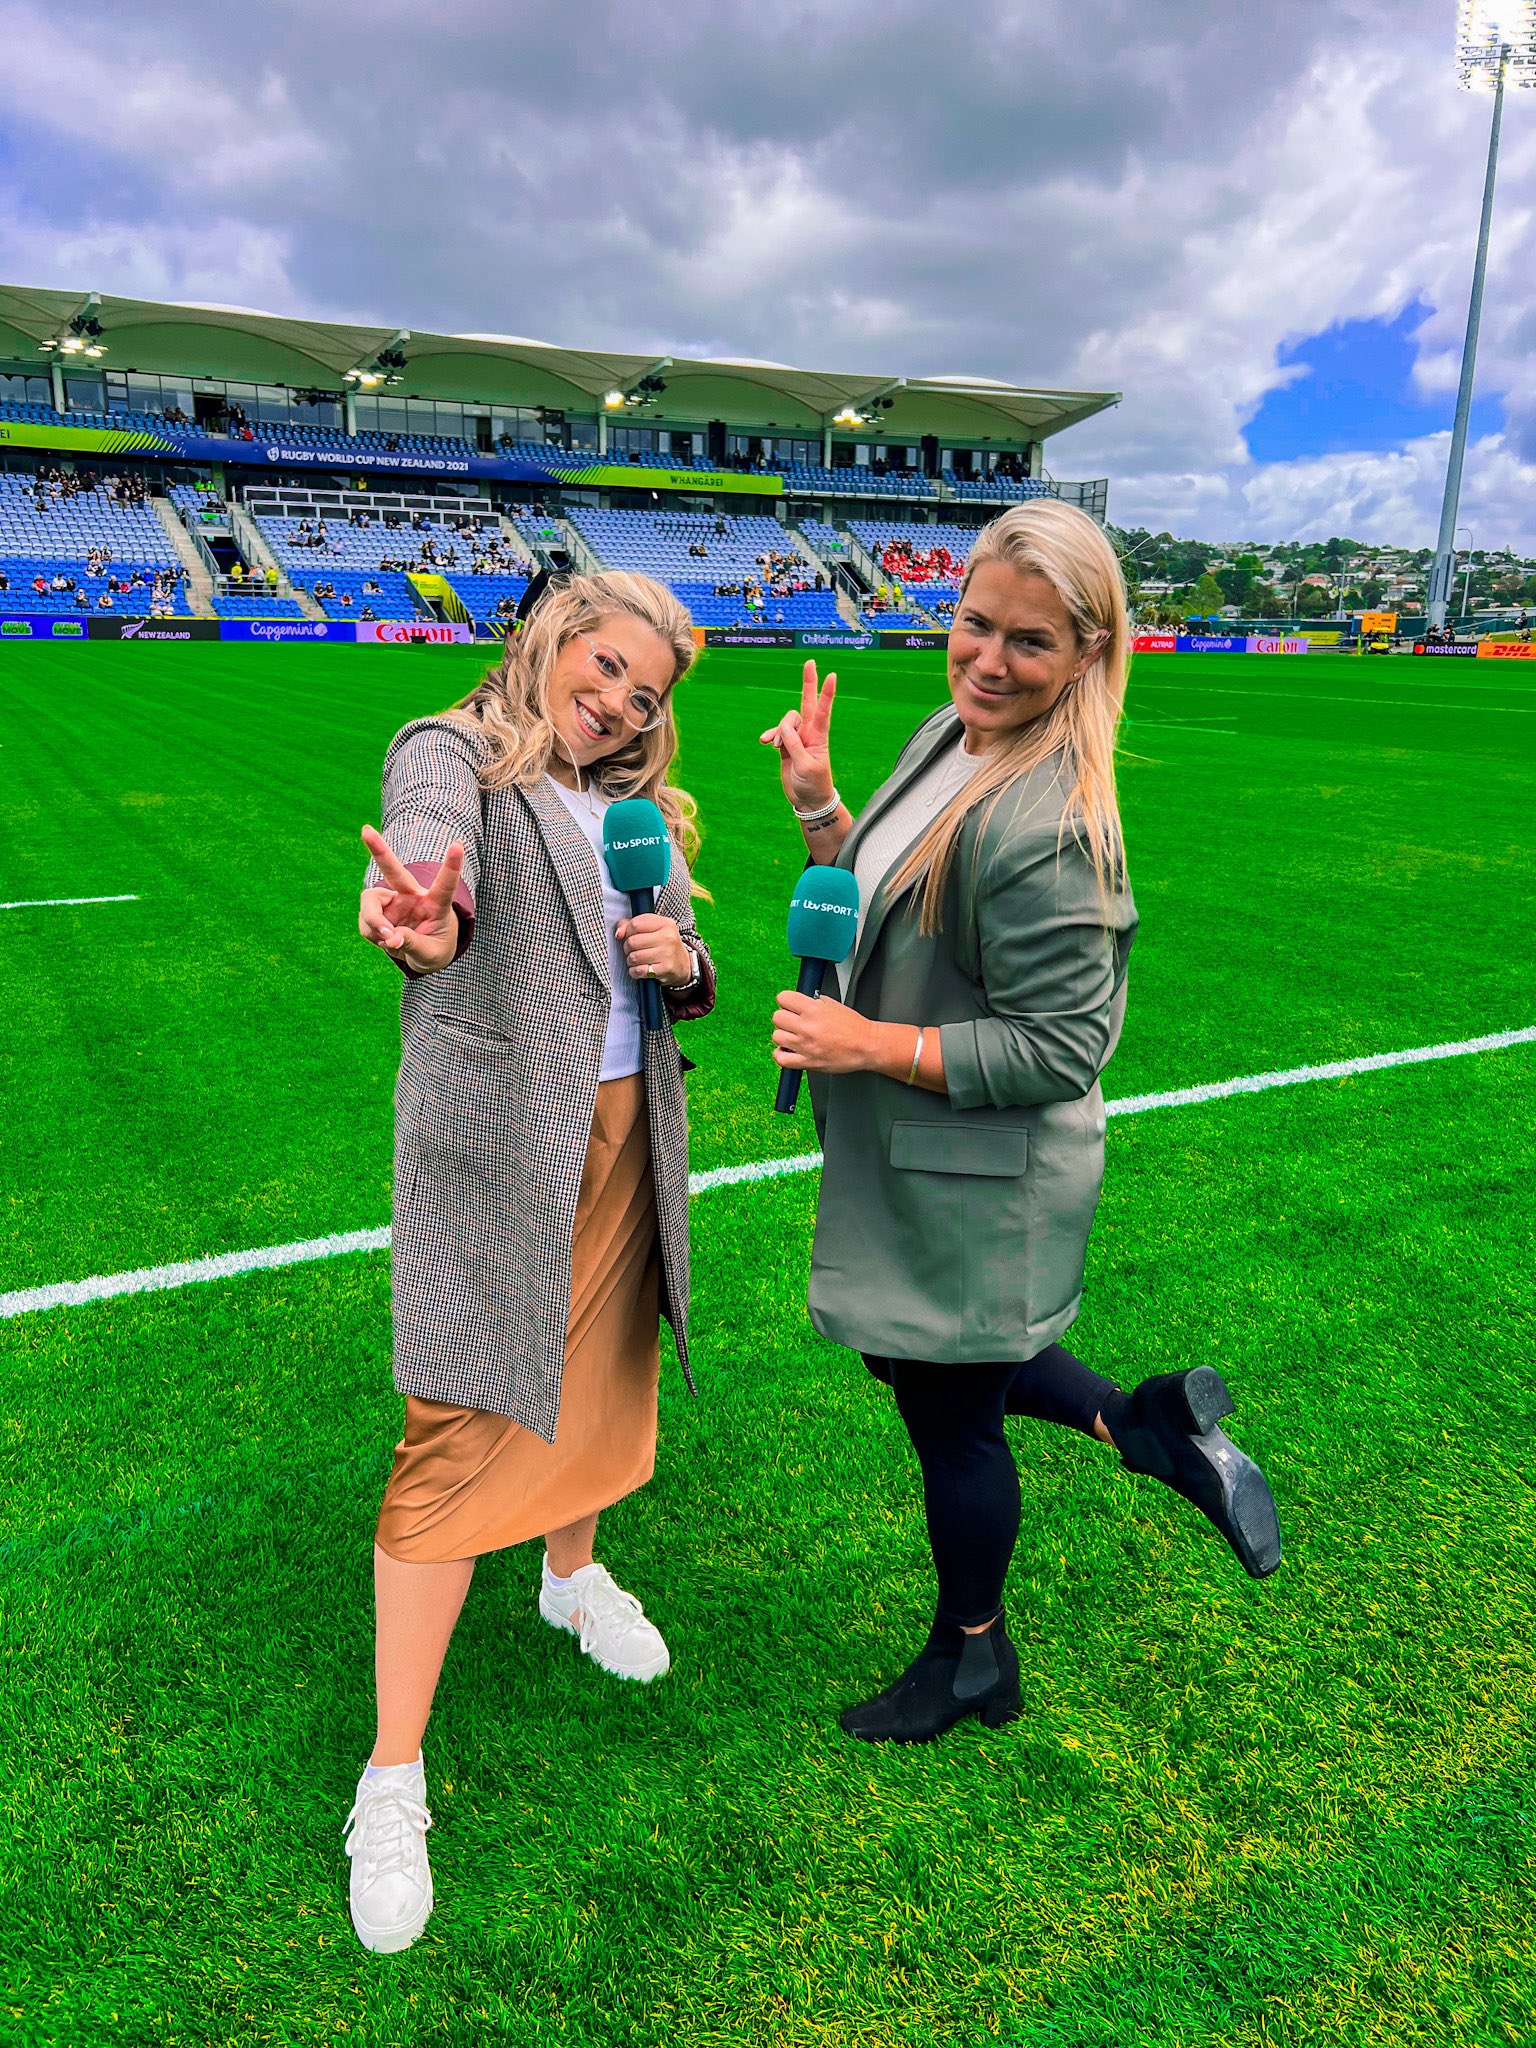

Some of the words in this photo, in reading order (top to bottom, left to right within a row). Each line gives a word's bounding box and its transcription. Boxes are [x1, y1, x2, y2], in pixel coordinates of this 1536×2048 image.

[281, 450, 315, 461] RUGBY
[316, 452, 354, 464] WORLD
[355, 455, 375, 465] CUP
[376, 456, 400, 467] NEW
[401, 458, 446, 470] ZEALAND
[446, 461, 469, 471] 2021
[53, 627, 82, 635] MOVE
[138, 631, 156, 639] NEW
[156, 631, 191, 639] ZEALAND
[250, 621, 314, 641] Capgemini
[375, 623, 452, 642] Canon
[724, 636, 776, 644] DEFENDER
[1150, 640, 1174, 649] ALTRAD
[1191, 637, 1225, 652] Capgemini
[1256, 639, 1298, 653] Canon
[1426, 644, 1477, 655] mastercard
[1492, 645, 1532, 657] DHL
[612, 840, 630, 851] itv
[629, 836, 661, 848] SPORT
[803, 899, 821, 911] itv
[820, 902, 853, 917] SPORT
